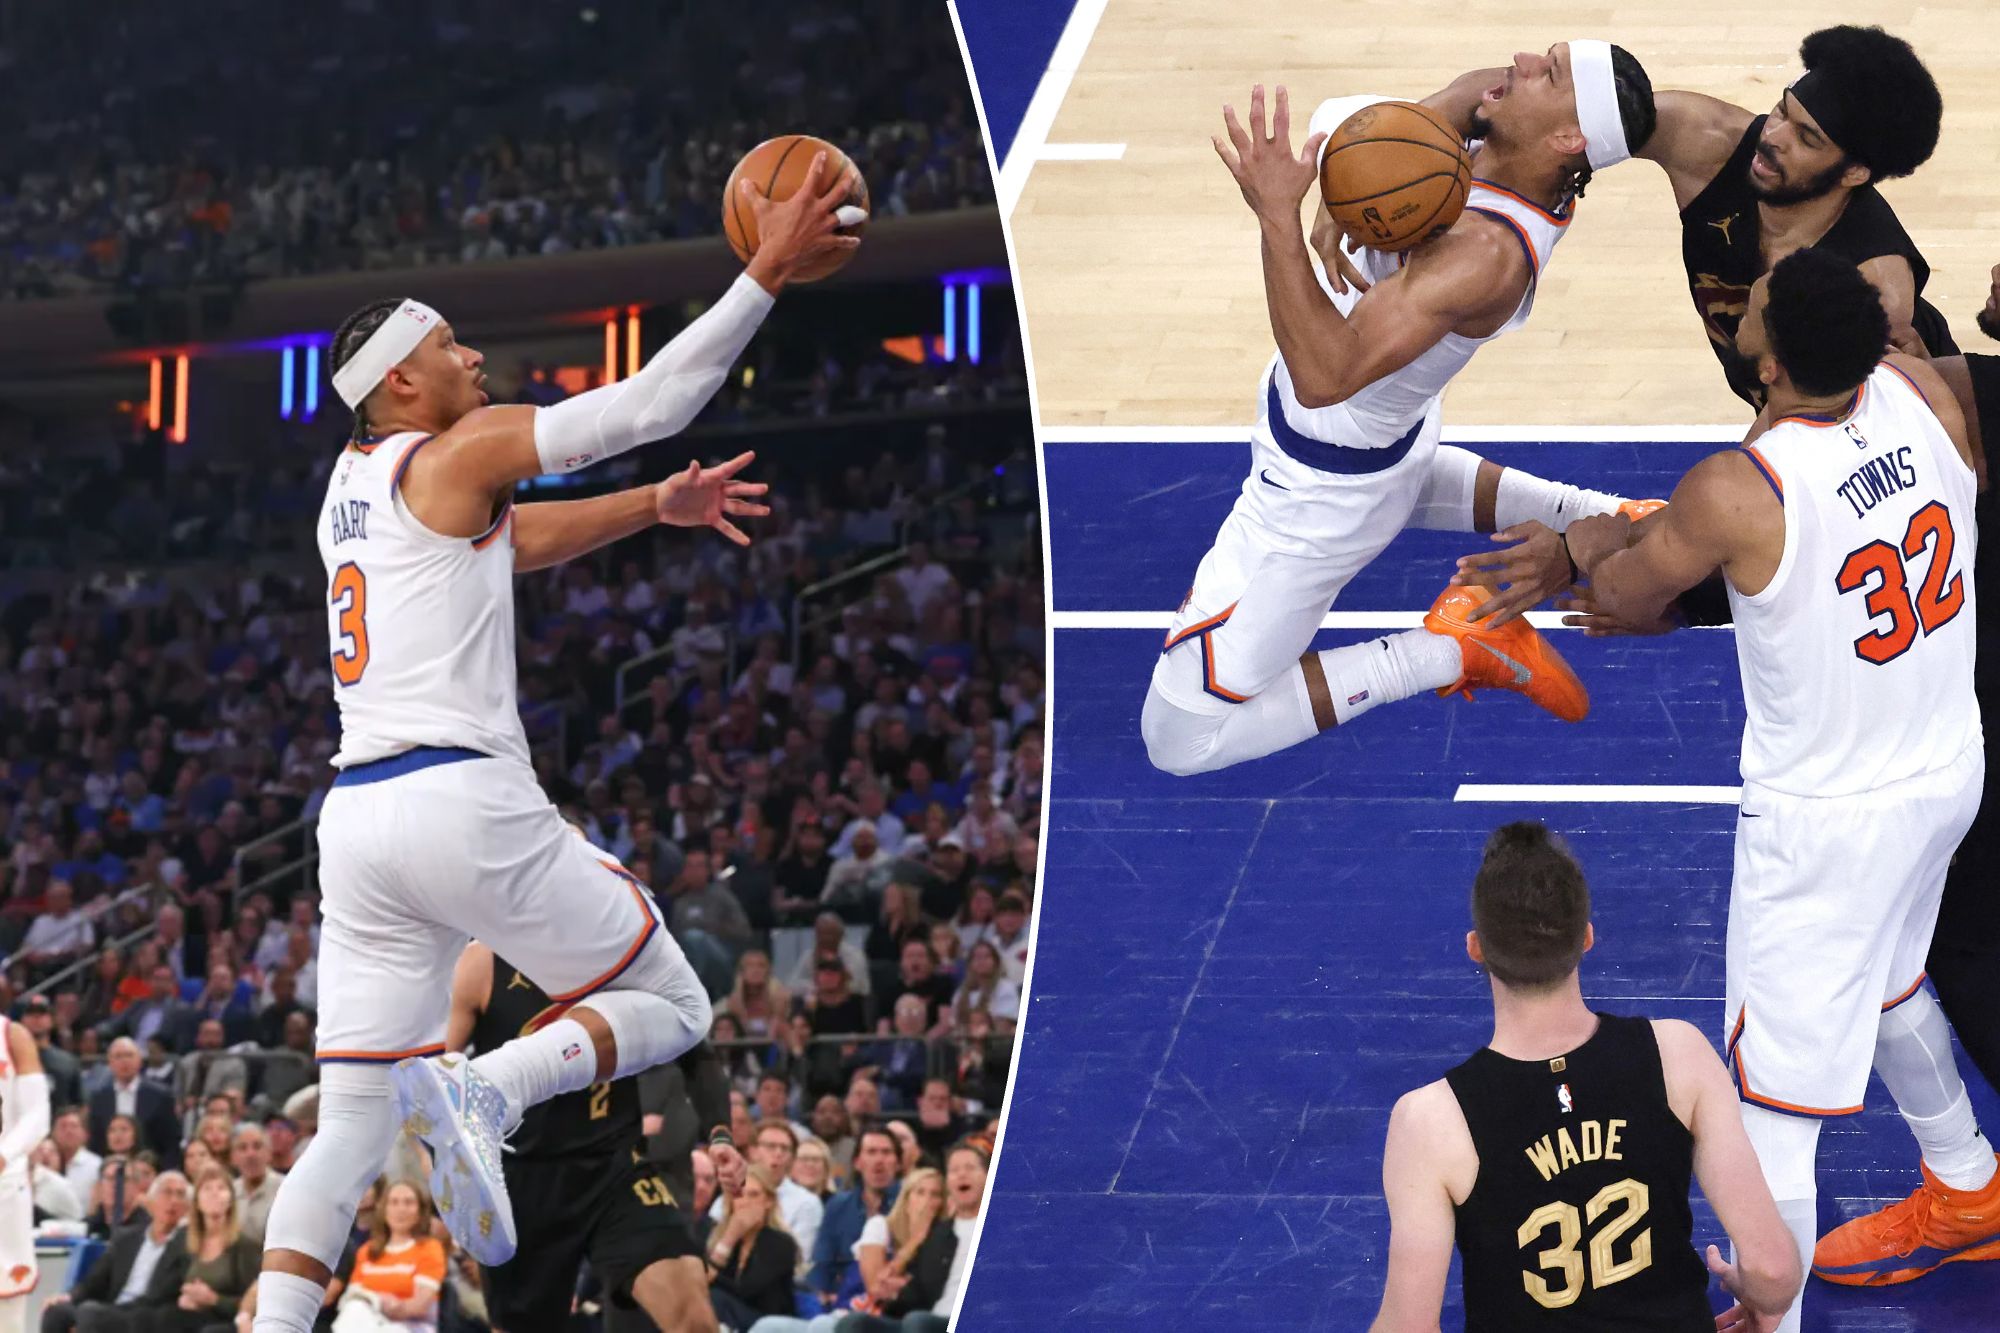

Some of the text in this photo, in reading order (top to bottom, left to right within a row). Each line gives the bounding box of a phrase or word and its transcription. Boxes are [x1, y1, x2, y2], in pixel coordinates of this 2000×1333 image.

[331, 500, 370, 546] HART
[1836, 446, 1916, 520] TOWNS
[332, 560, 370, 688] 3
[1835, 499, 1965, 666] 32
[1525, 1119, 1627, 1182] WADE
[1517, 1177, 1652, 1309] 32
